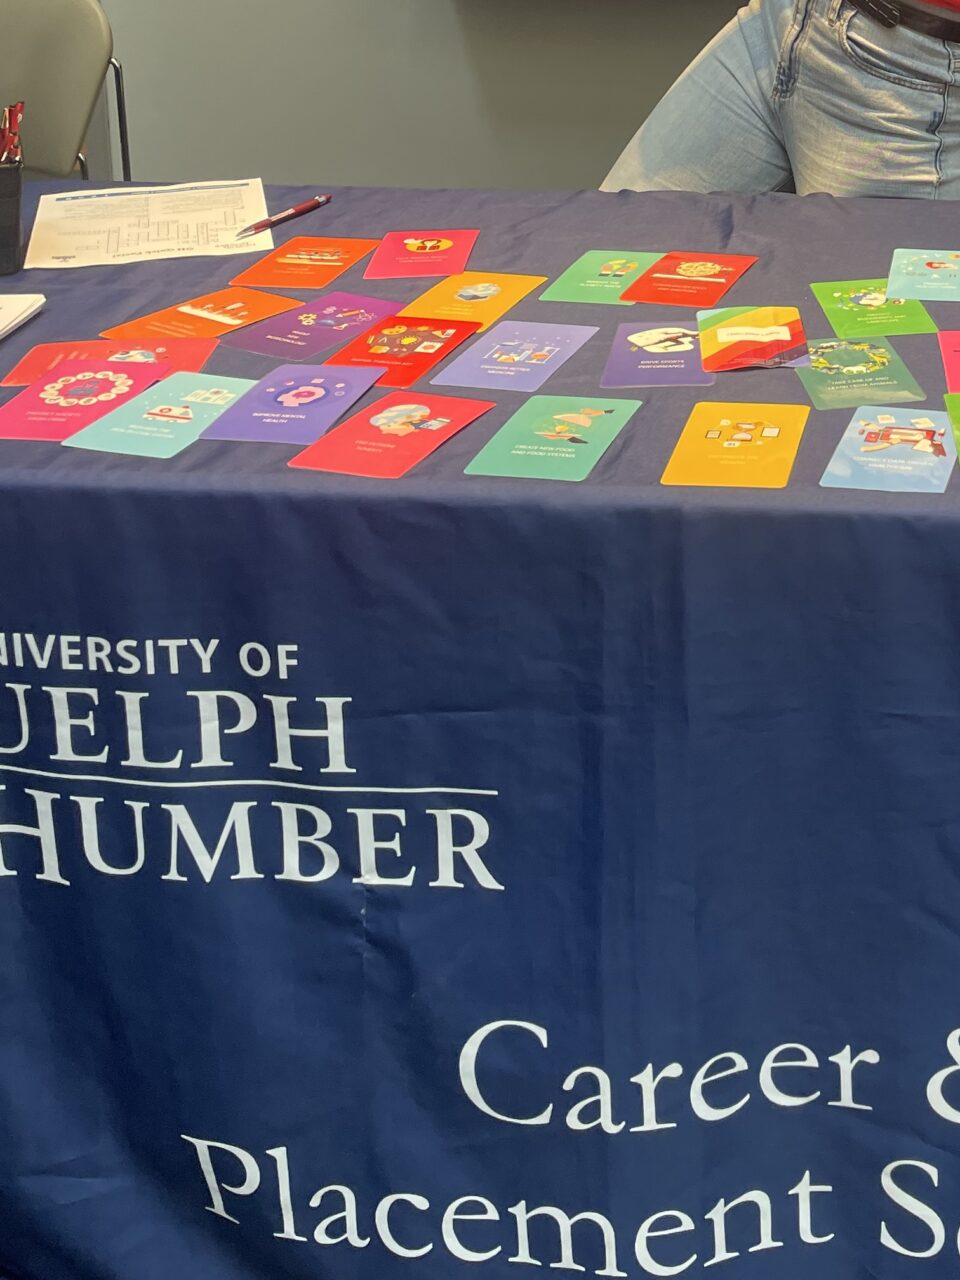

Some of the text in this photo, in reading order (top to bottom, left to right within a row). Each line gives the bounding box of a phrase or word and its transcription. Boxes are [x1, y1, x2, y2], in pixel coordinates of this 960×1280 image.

[239, 641, 299, 679] OF
[458, 1020, 880, 1134] Career
[180, 1134, 835, 1277] Placement
